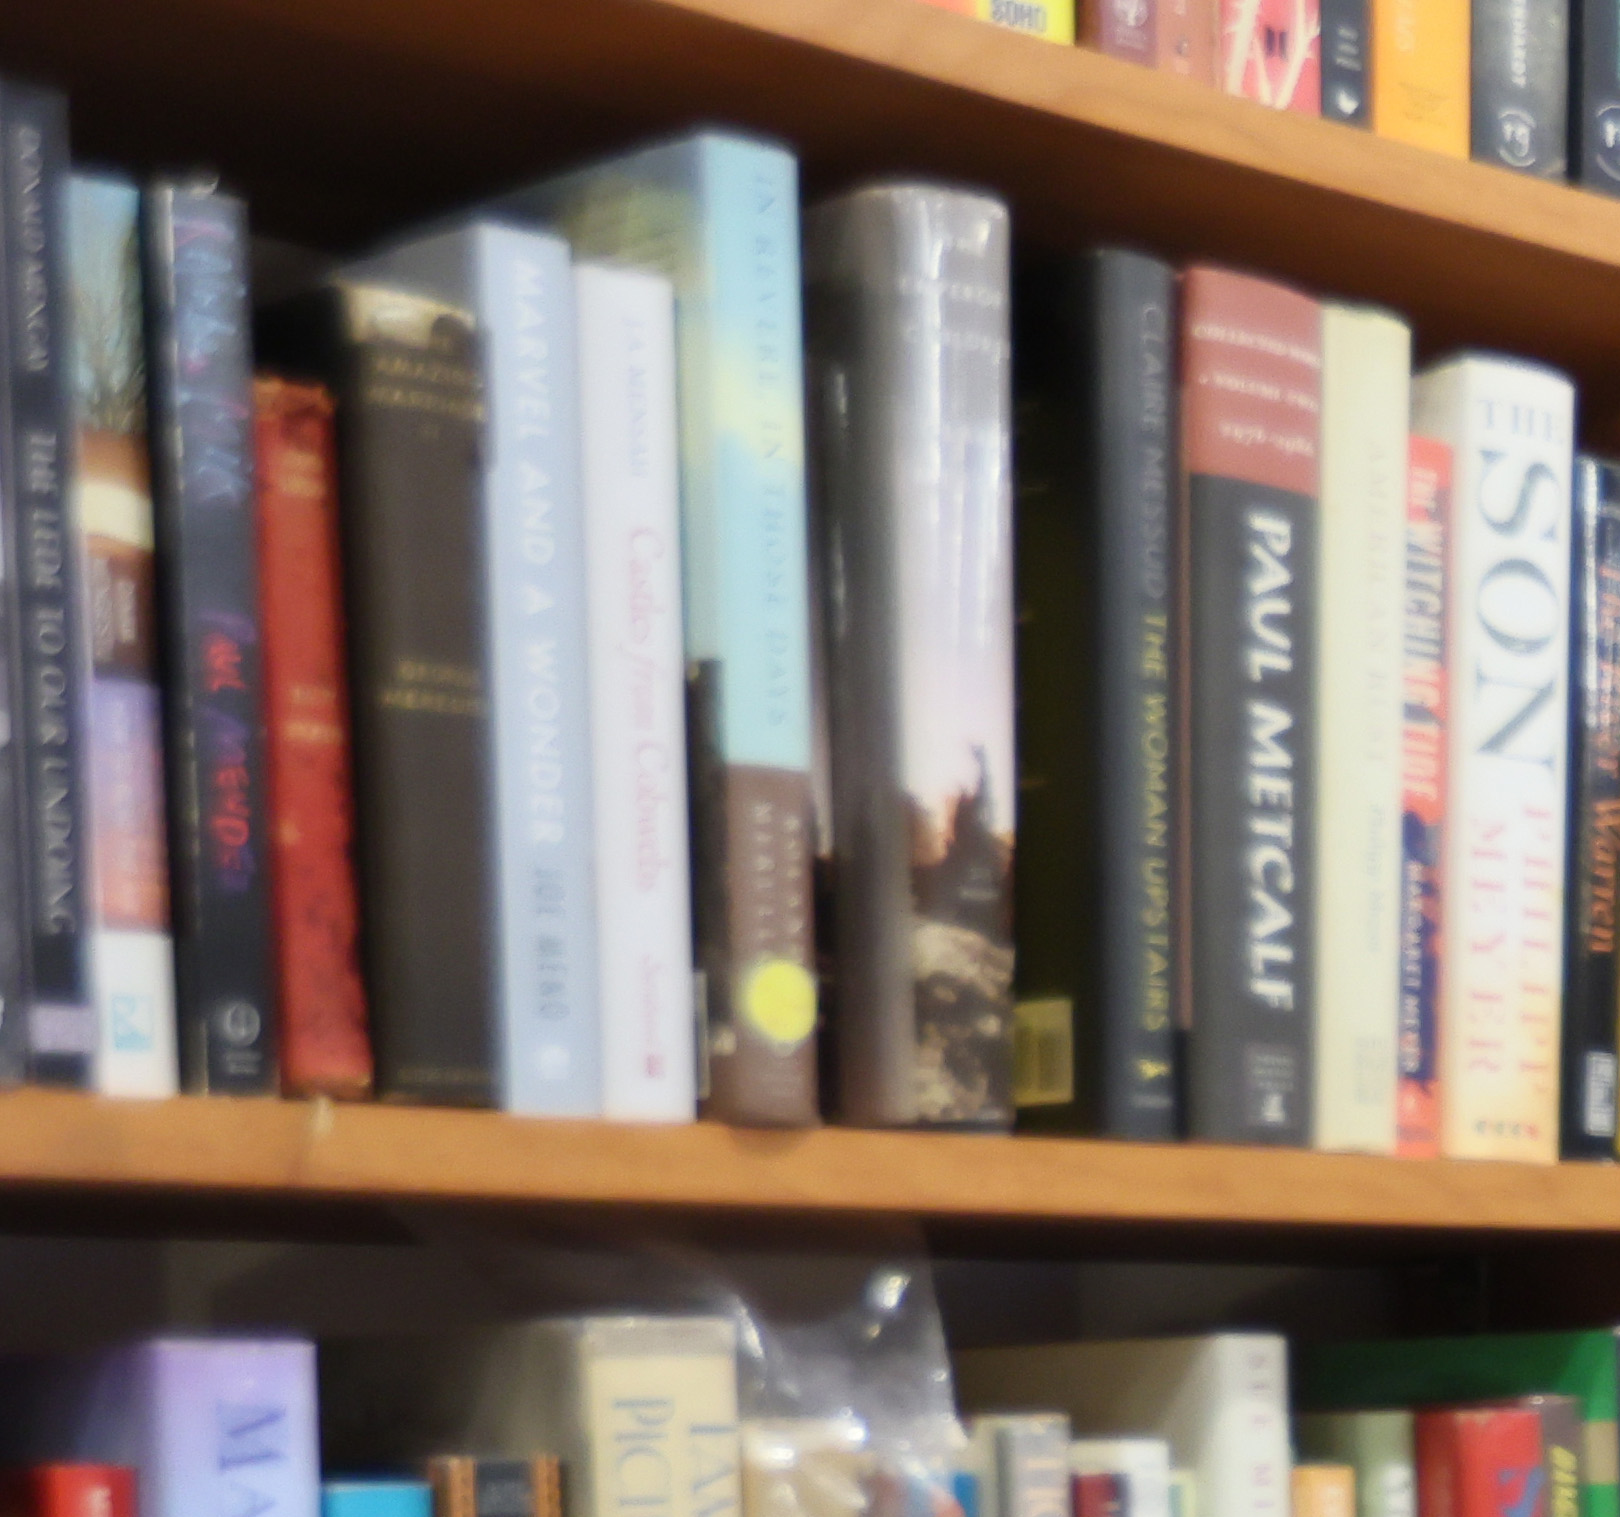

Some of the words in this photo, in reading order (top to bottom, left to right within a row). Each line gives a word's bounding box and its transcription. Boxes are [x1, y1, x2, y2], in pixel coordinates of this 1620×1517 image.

[510, 258, 556, 441] MARVEL
[1479, 400, 1565, 442] THE
[515, 462, 558, 561] AND
[522, 583, 558, 618] A
[1246, 512, 1294, 683] PAUL
[1139, 611, 1168, 680] THE
[1402, 519, 1447, 709] WITCHING
[1474, 448, 1561, 781] SON
[523, 640, 566, 846] WONDER
[1139, 693, 1170, 849] WOMAN
[1140, 856, 1170, 1032] UPSTAIRS
[1246, 701, 1298, 1016] METCALF
[1466, 818, 1509, 1075] MEYER
[1519, 806, 1556, 1099] PHILIPP
